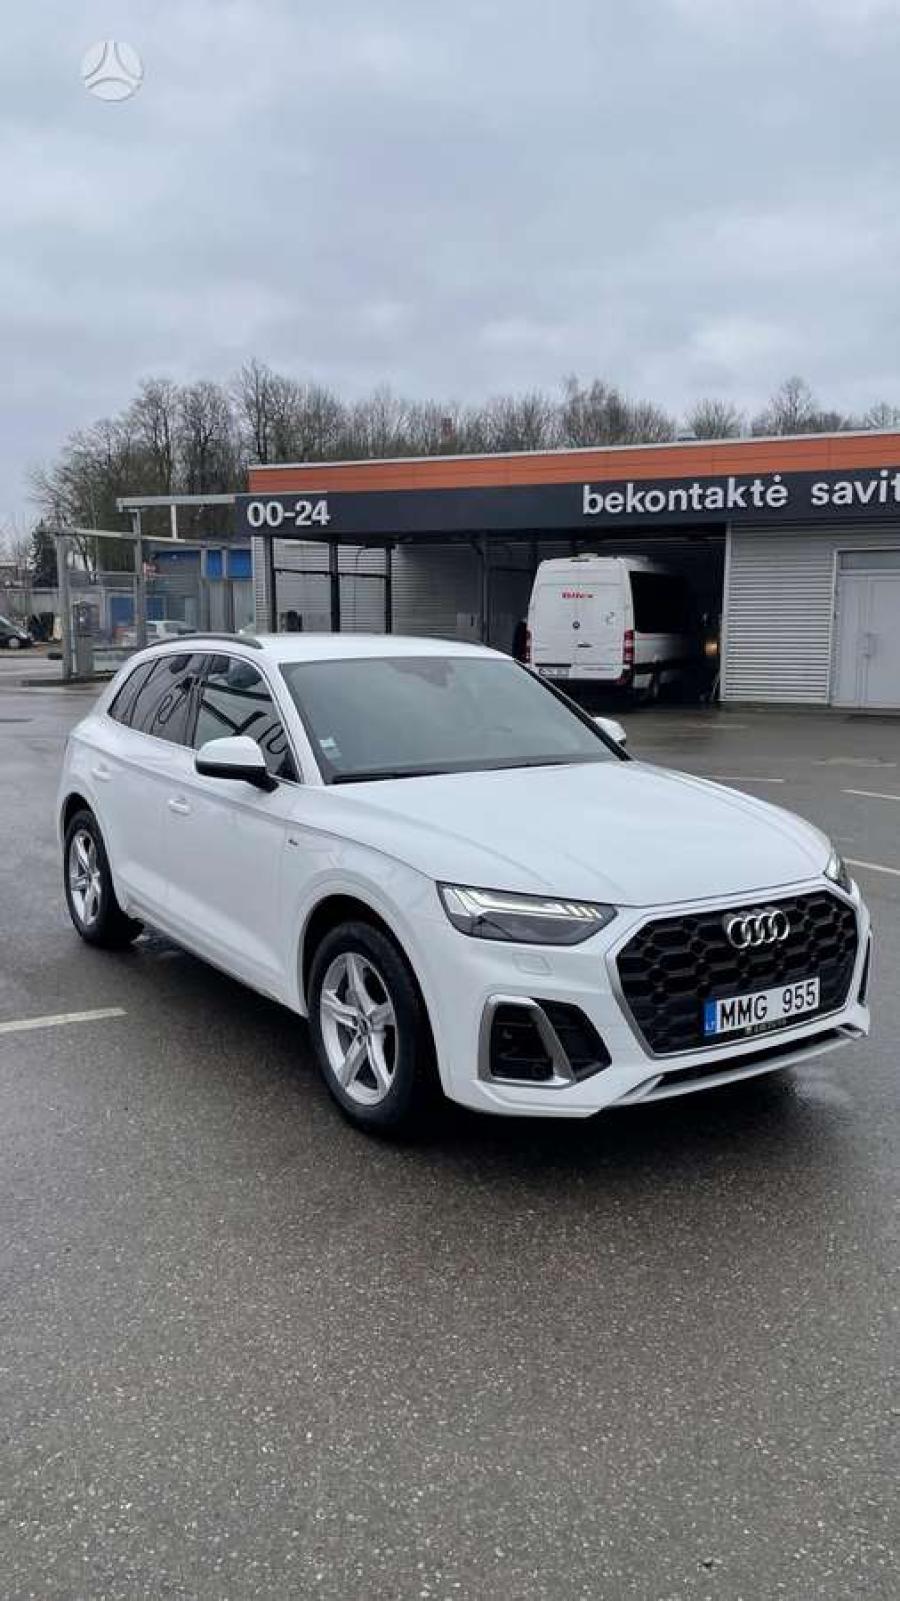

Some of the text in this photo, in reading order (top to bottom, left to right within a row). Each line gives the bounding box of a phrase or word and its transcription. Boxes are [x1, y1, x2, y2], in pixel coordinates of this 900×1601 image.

[247, 500, 331, 527] 00-24
[583, 474, 789, 514] bekontaktė
[721, 995, 767, 1029] MMG
[782, 981, 816, 1013] 955
